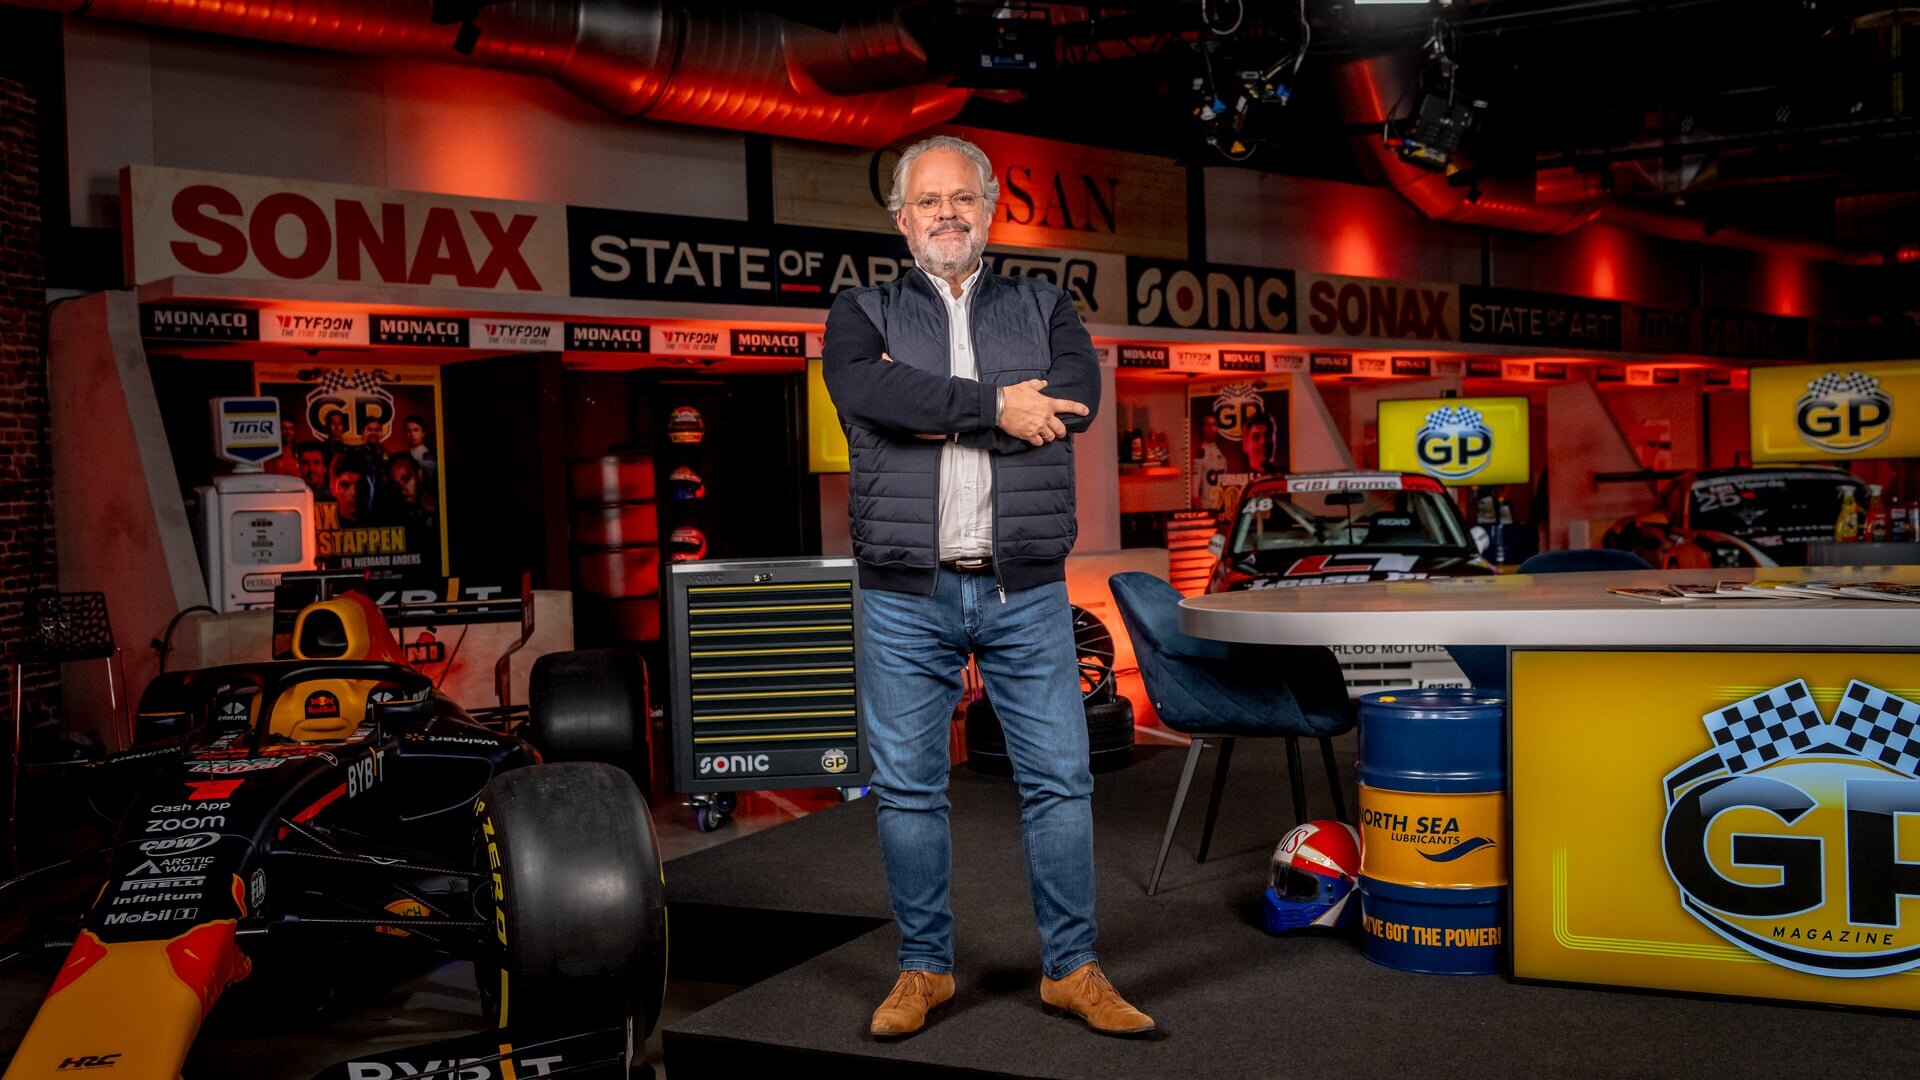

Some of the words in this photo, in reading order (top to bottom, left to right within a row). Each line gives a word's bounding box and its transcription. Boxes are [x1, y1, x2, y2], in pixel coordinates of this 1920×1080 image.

[169, 184, 543, 292] SONAX
[590, 234, 771, 290] STATE
[778, 248, 825, 277] OF
[829, 253, 914, 295] AR
[153, 309, 248, 328] MONACO
[1308, 280, 1453, 341] SONAX
[293, 315, 353, 330] TYFOON
[380, 319, 460, 336] MONACO
[1467, 303, 1543, 337] STATE
[1569, 311, 1614, 340] ART
[498, 324, 551, 338] TYFOON
[573, 327, 642, 342] MONACO
[674, 331, 719, 344] TYFOON
[738, 333, 799, 348] MONACO
[1122, 348, 1165, 360] MONACO
[1796, 400, 1893, 439] GP
[1416, 429, 1493, 466] GP
[313, 501, 339, 531] AX
[1328, 645, 1376, 655] RLOO
[347, 746, 385, 799] BYBIT
[699, 754, 770, 775] SONIC
[823, 758, 847, 770] GP
[149, 803, 192, 814] Cash
[195, 801, 231, 813] App
[144, 814, 226, 833] zoom
[1416, 816, 1460, 835] SEA
[138, 835, 202, 852] CDW
[1390, 832, 1461, 845] LUBRICANTS
[159, 856, 216, 867] ARCTIC
[164, 864, 208, 873] WOLF
[481, 816, 507, 947] ZERO
[103, 909, 173, 926] Mobil
[1385, 921, 1409, 944] GOT
[1411, 926, 1442, 947] THE
[1444, 926, 1503, 948] POWER!
[1772, 925, 1895, 945] MAGAZINE
[58, 1053, 122, 1070] HRC
